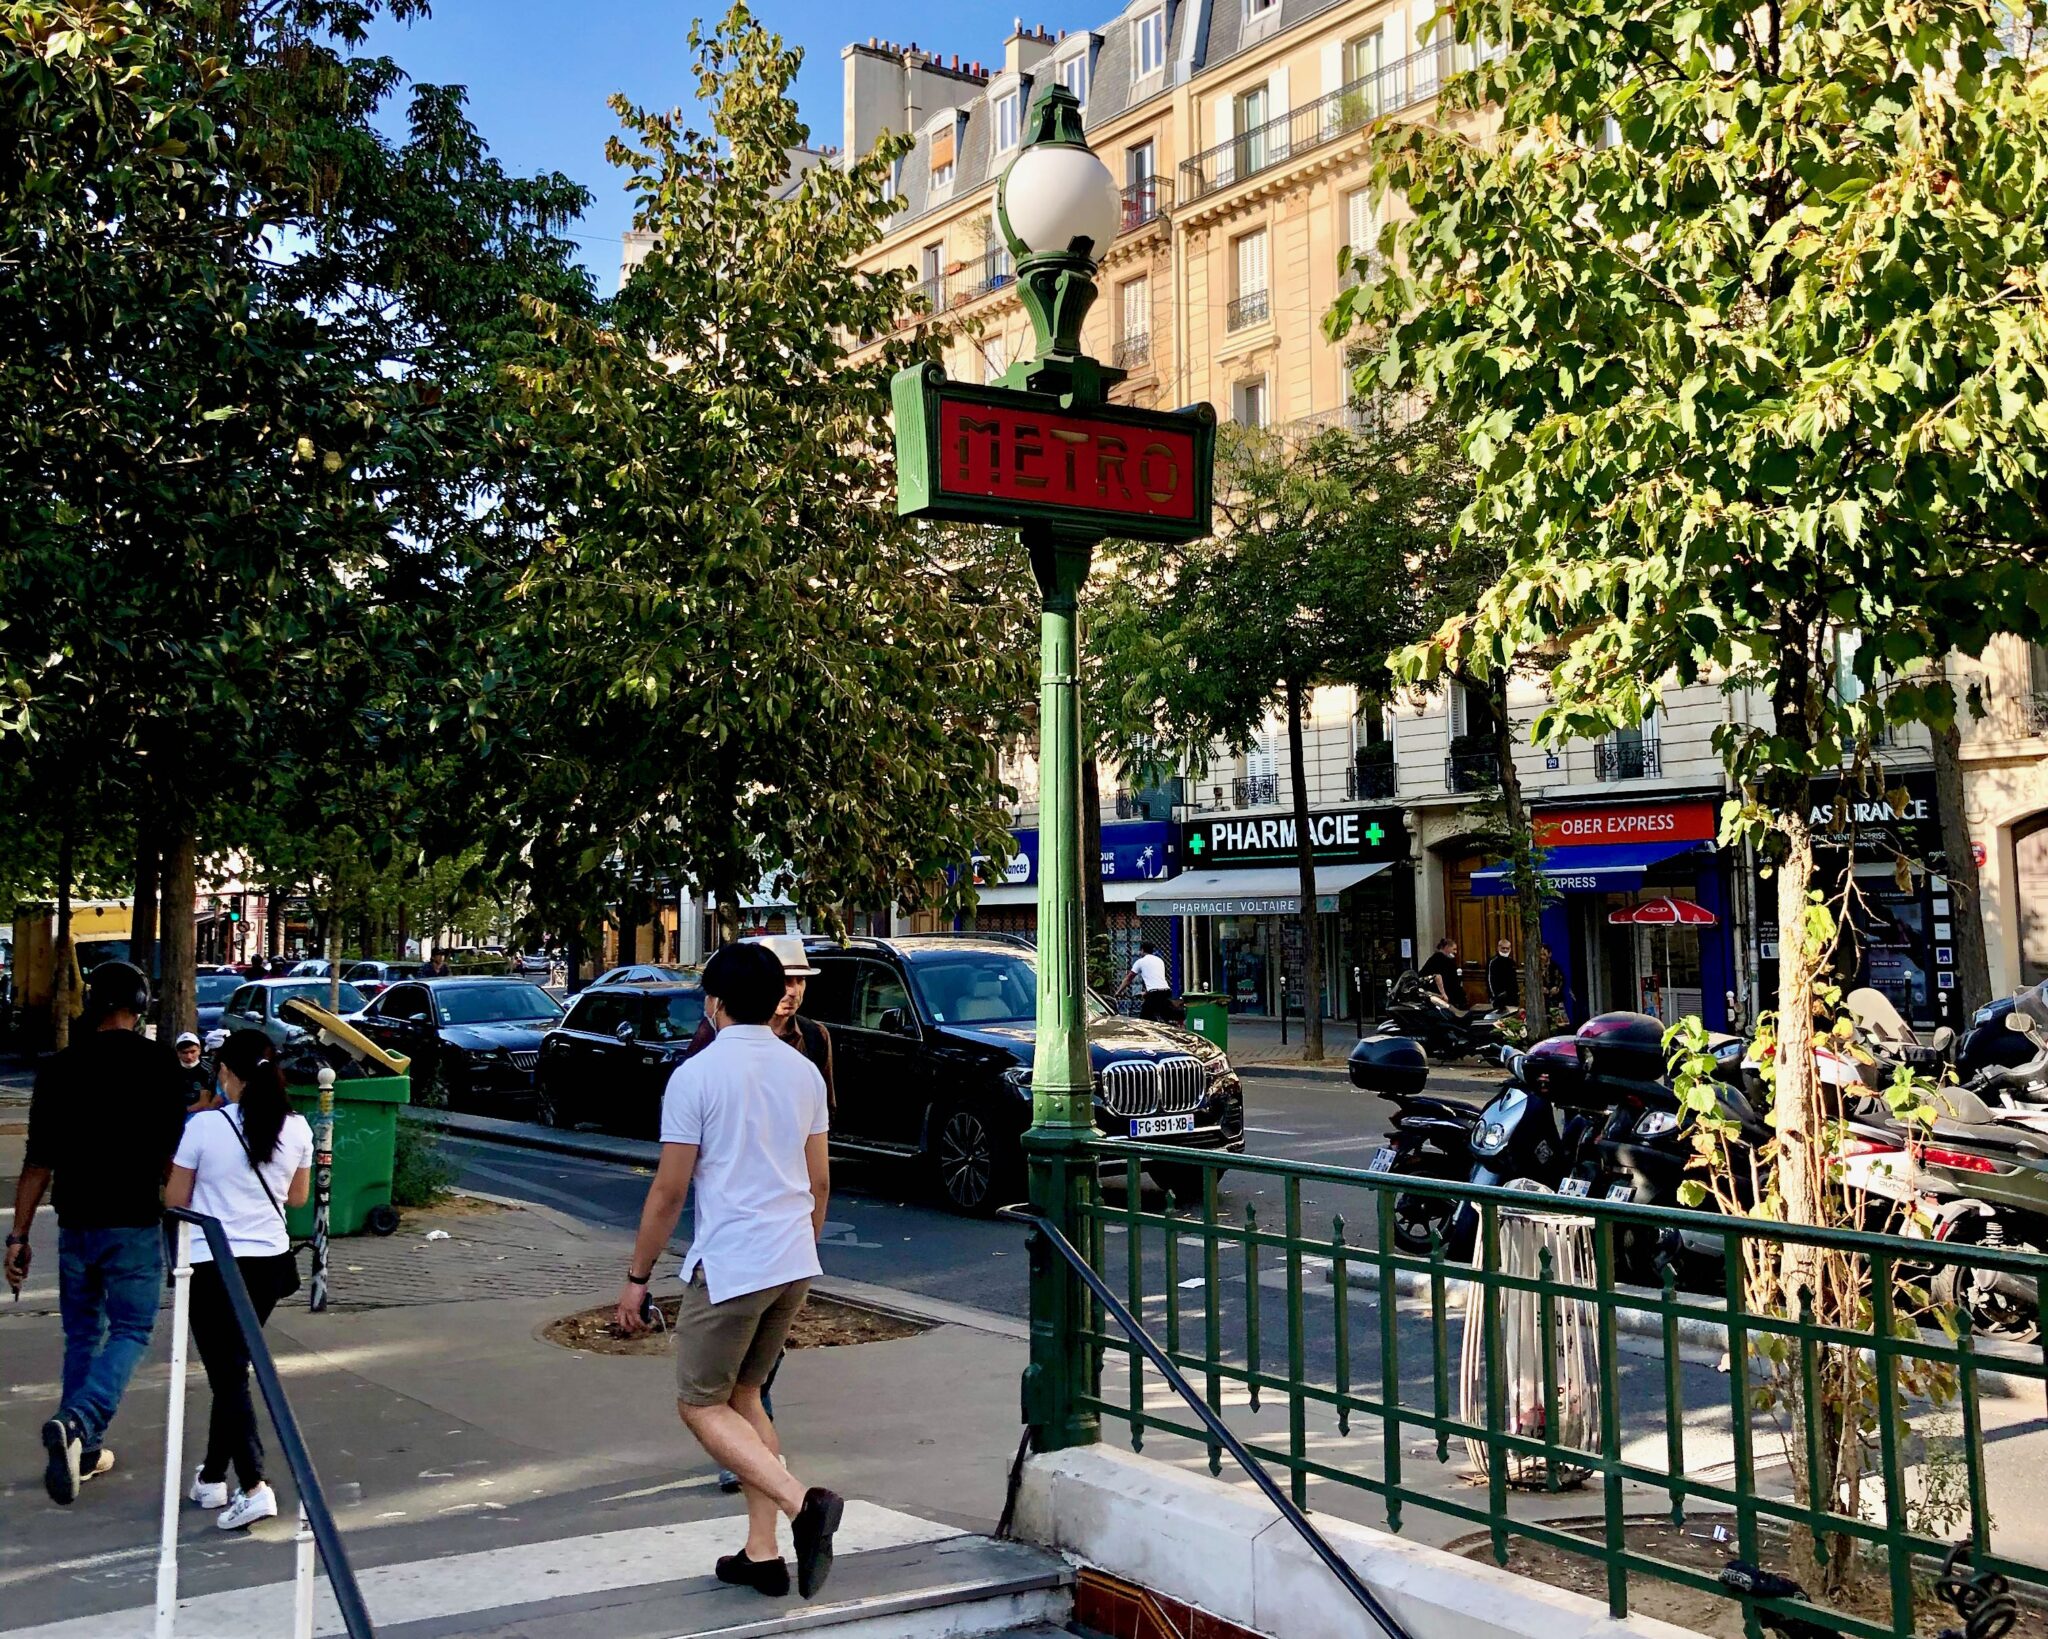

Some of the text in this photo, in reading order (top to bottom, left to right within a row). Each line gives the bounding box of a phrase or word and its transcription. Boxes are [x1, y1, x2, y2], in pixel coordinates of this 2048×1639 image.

[958, 415, 1178, 503] METRO
[1809, 799, 1929, 824] ASURANCE
[1211, 814, 1360, 851] PHARMACIE
[1560, 814, 1675, 836] OBER EXPRESS
[1100, 851, 1115, 862] OUR
[1101, 862, 1115, 875] US
[1547, 876, 1597, 889] EXPRESS
[1172, 900, 1295, 913] PHARMACIE VOLTAIRE
[1138, 1117, 1187, 1134] FG-991-XB
